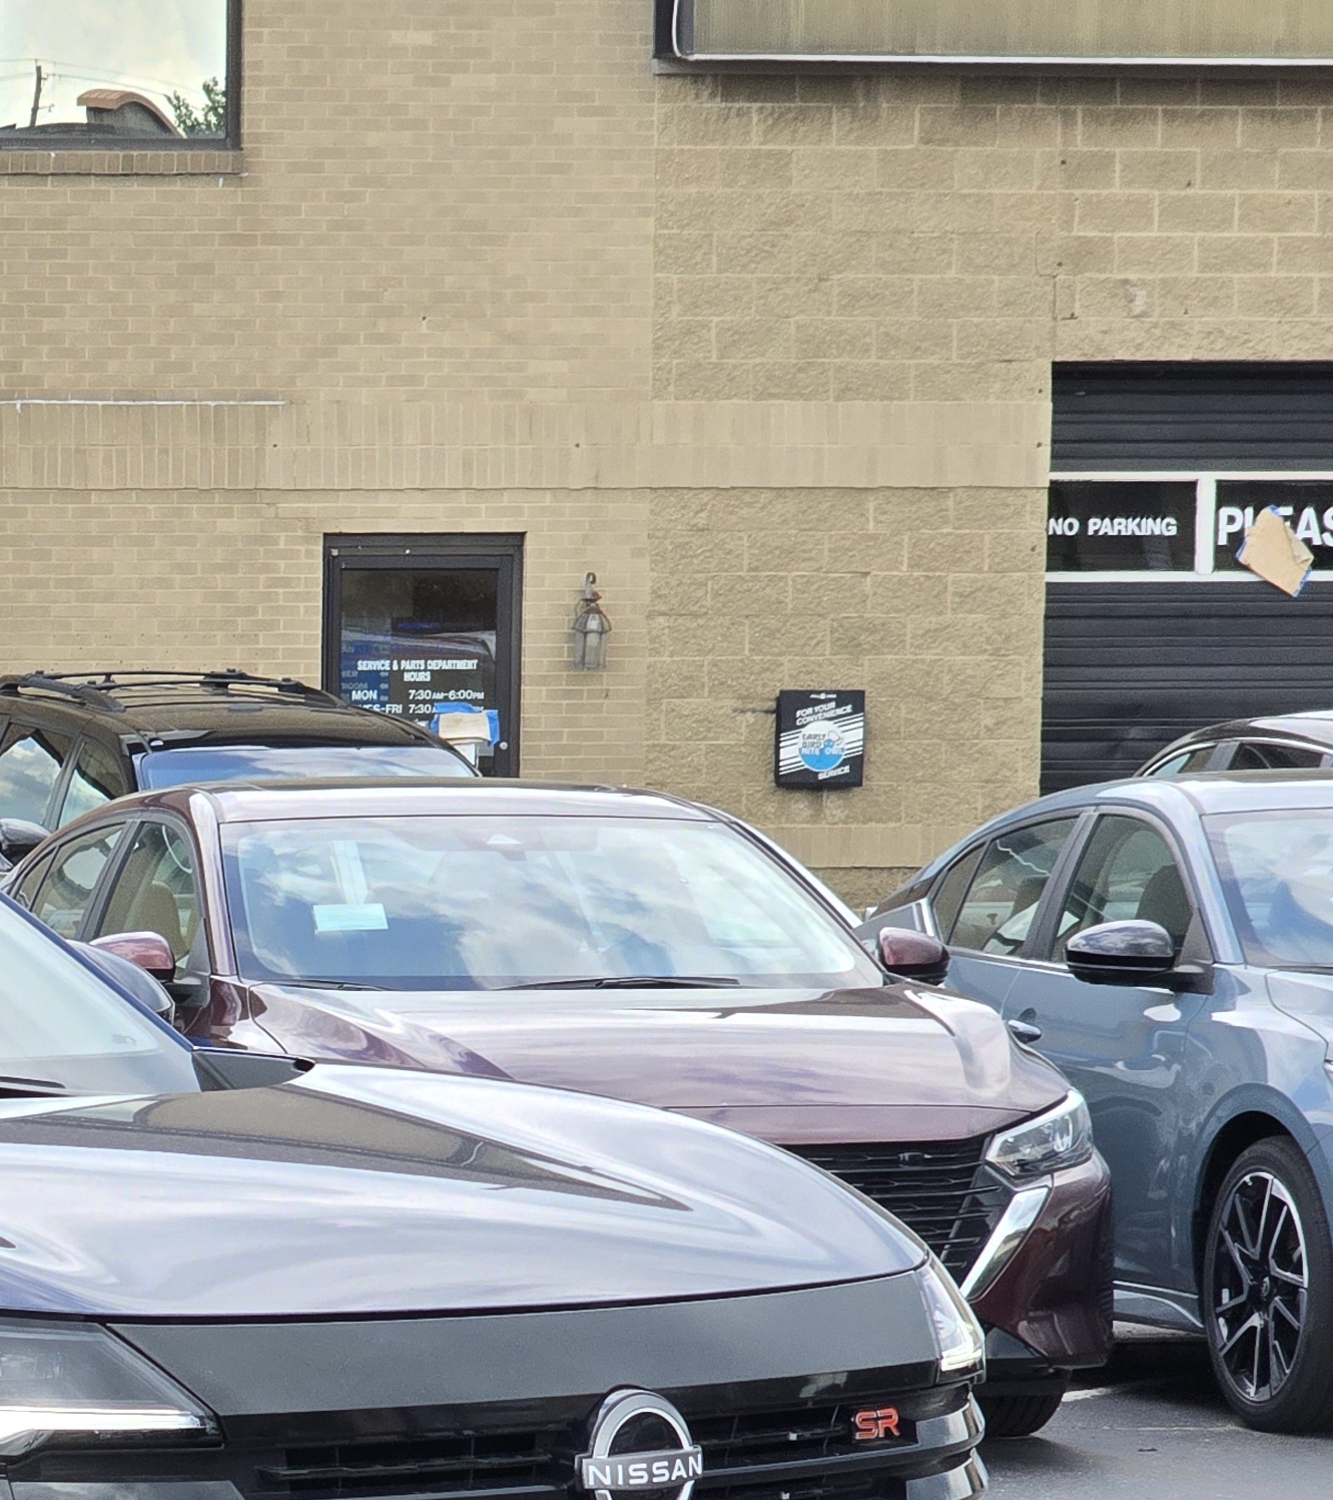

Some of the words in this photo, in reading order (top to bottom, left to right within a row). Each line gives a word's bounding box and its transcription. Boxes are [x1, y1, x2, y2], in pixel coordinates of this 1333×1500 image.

[1048, 518, 1079, 536] NO
[1087, 517, 1177, 536] PARKING
[357, 660, 391, 671] SERVICE
[400, 660, 425, 670] PARTS
[426, 659, 478, 670] DEPARTMENT
[404, 671, 431, 682] HOURS
[351, 690, 378, 701] MON
[855, 1408, 901, 1440] SR
[588, 1453, 703, 1486] NISSAN
